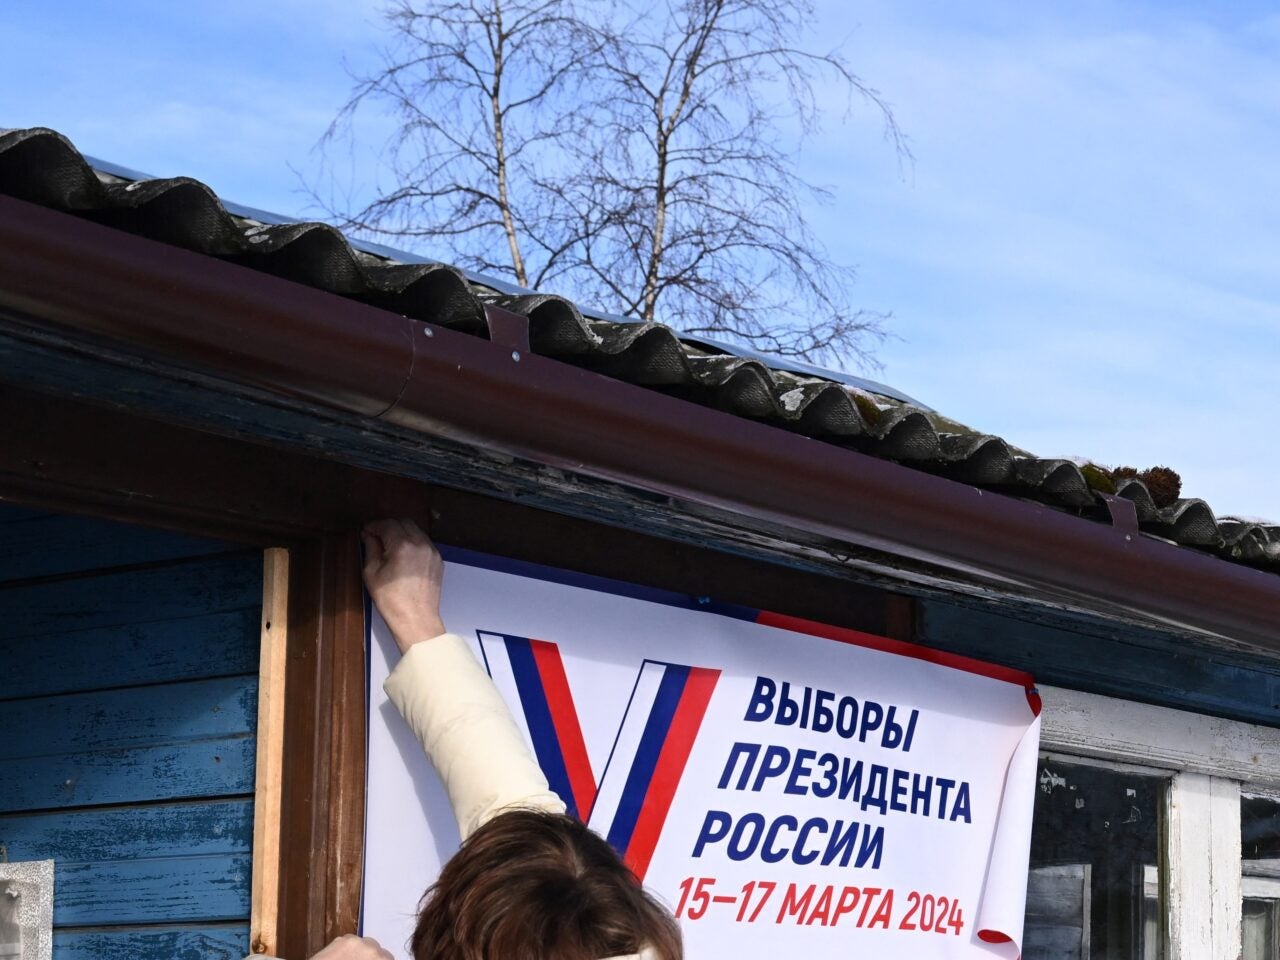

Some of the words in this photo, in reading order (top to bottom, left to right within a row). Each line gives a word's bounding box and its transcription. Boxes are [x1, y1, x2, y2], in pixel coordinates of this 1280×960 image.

[744, 676, 919, 752] ВЫБОРЫ
[717, 742, 972, 824] ПРЕЗИДЕНТА
[691, 810, 885, 869] РОССИИ
[776, 883, 895, 930] МАРТА
[899, 891, 964, 936] 2024
